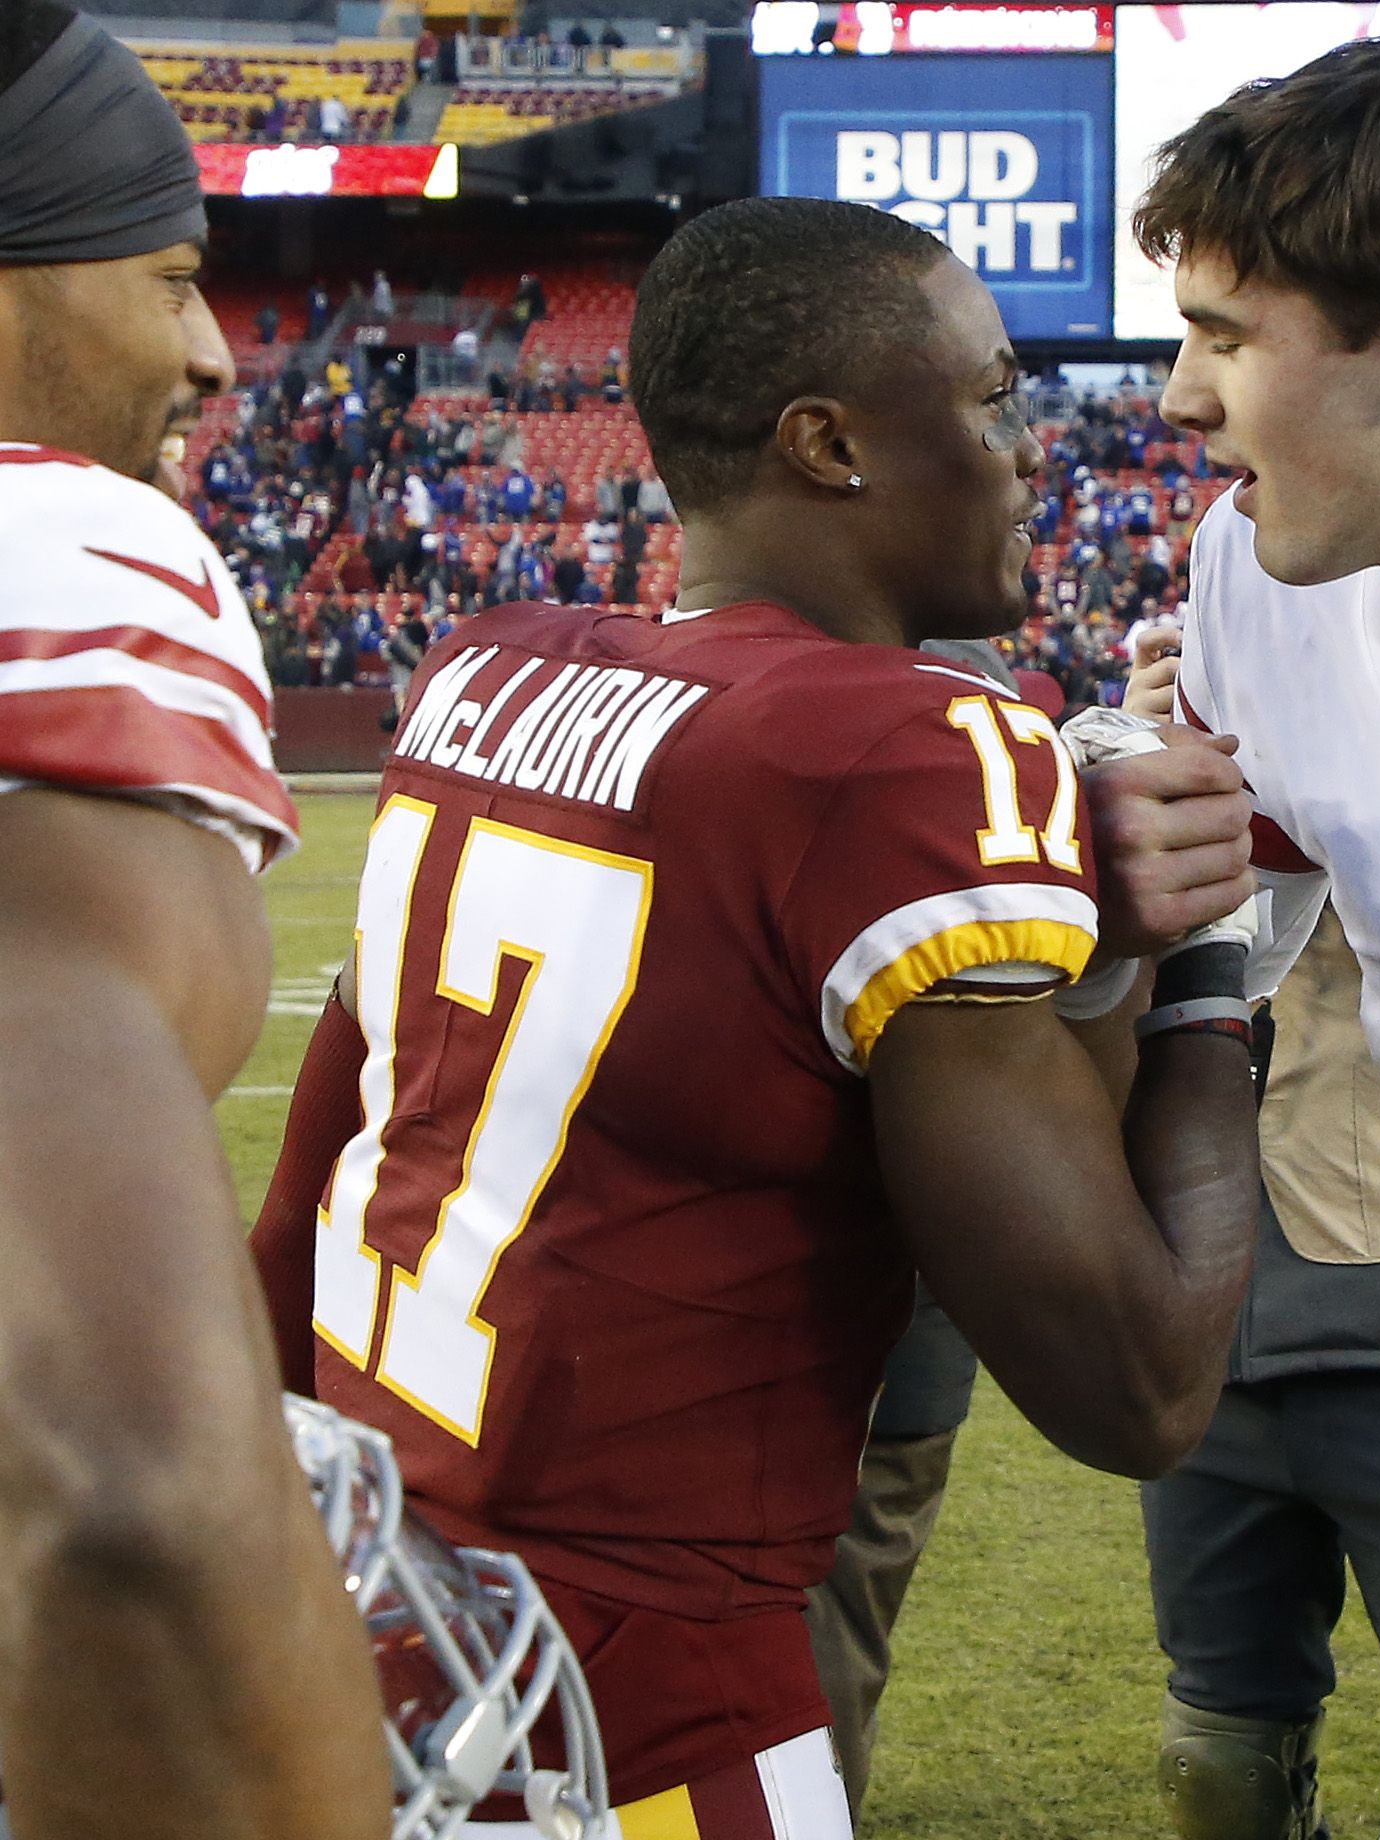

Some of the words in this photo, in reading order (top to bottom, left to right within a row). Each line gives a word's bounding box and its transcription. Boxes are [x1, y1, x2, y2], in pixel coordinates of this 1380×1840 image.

[836, 130, 1038, 199] BUD
[945, 694, 1083, 875] 17
[313, 793, 653, 1448] 17
